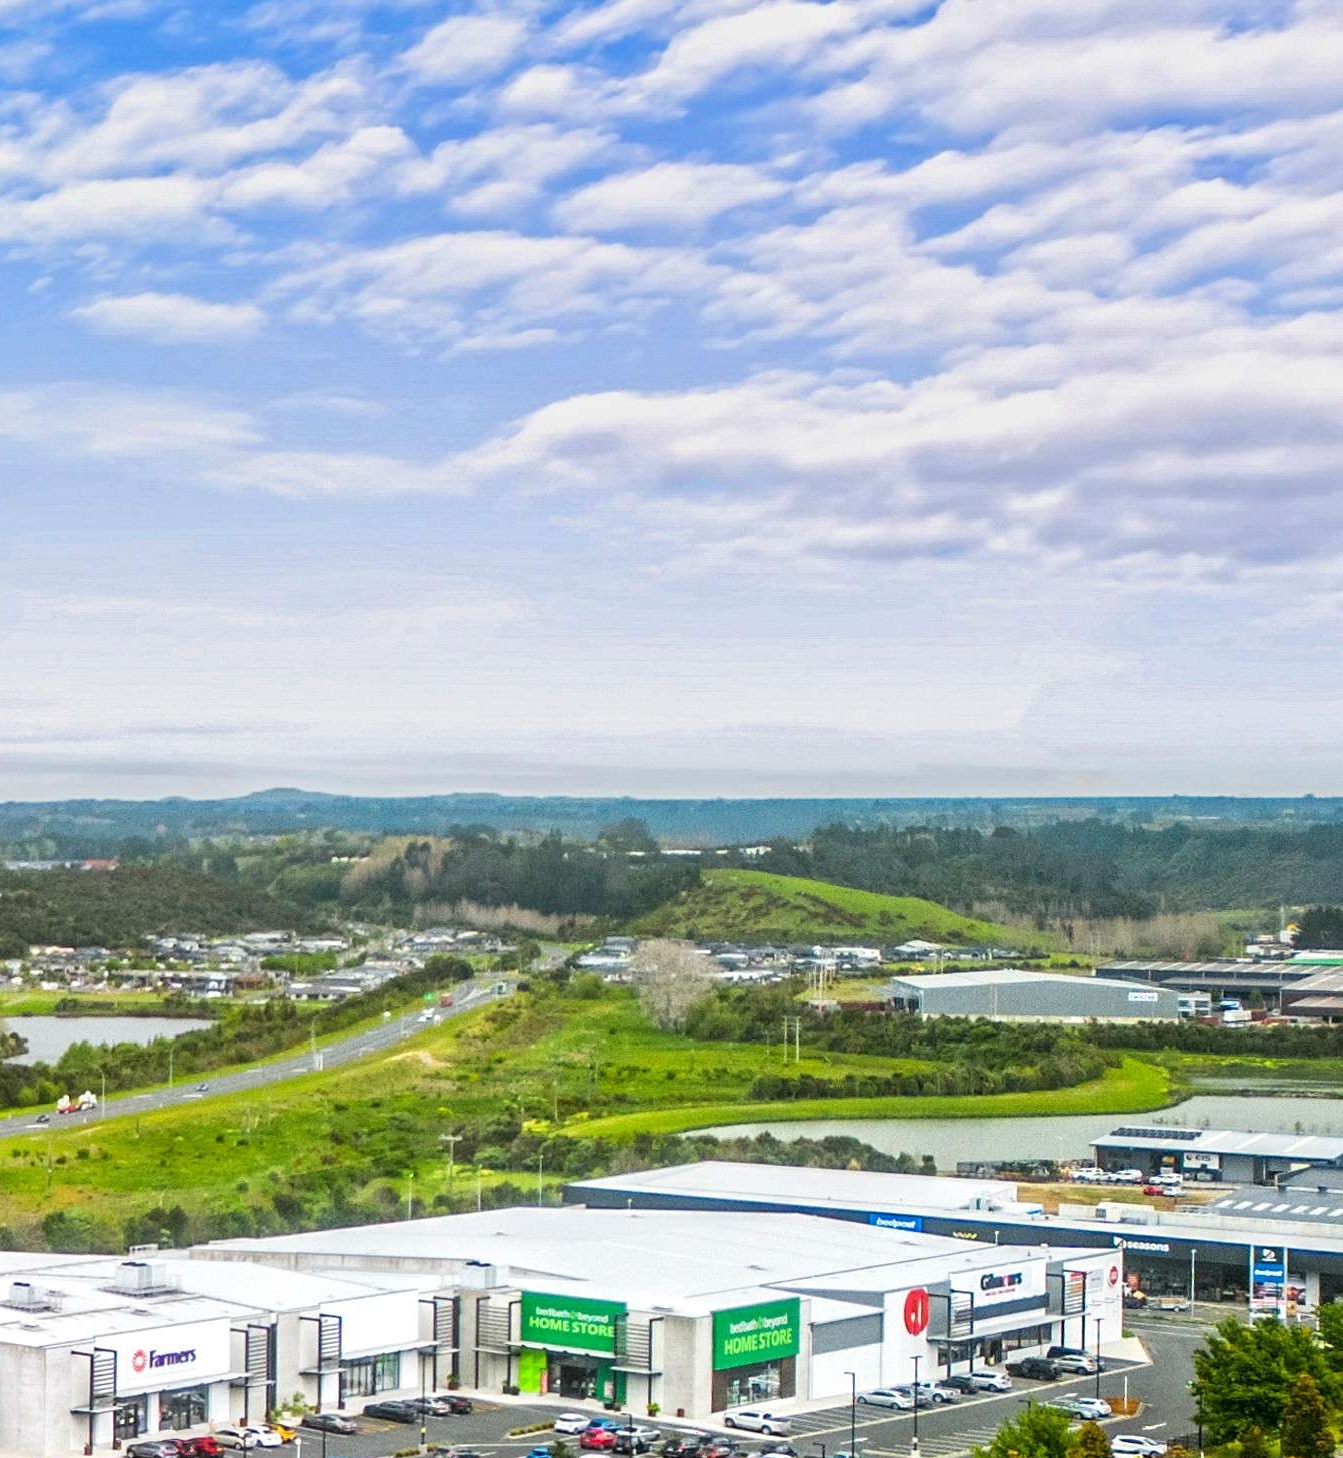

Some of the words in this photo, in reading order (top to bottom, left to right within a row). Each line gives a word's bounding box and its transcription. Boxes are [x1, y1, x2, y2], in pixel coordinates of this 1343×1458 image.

[529, 1316, 570, 1332] HOME
[571, 1321, 615, 1338] STORE
[723, 1334, 758, 1355] HOME
[759, 1328, 793, 1348] STORE
[149, 1348, 197, 1369] Farmers
